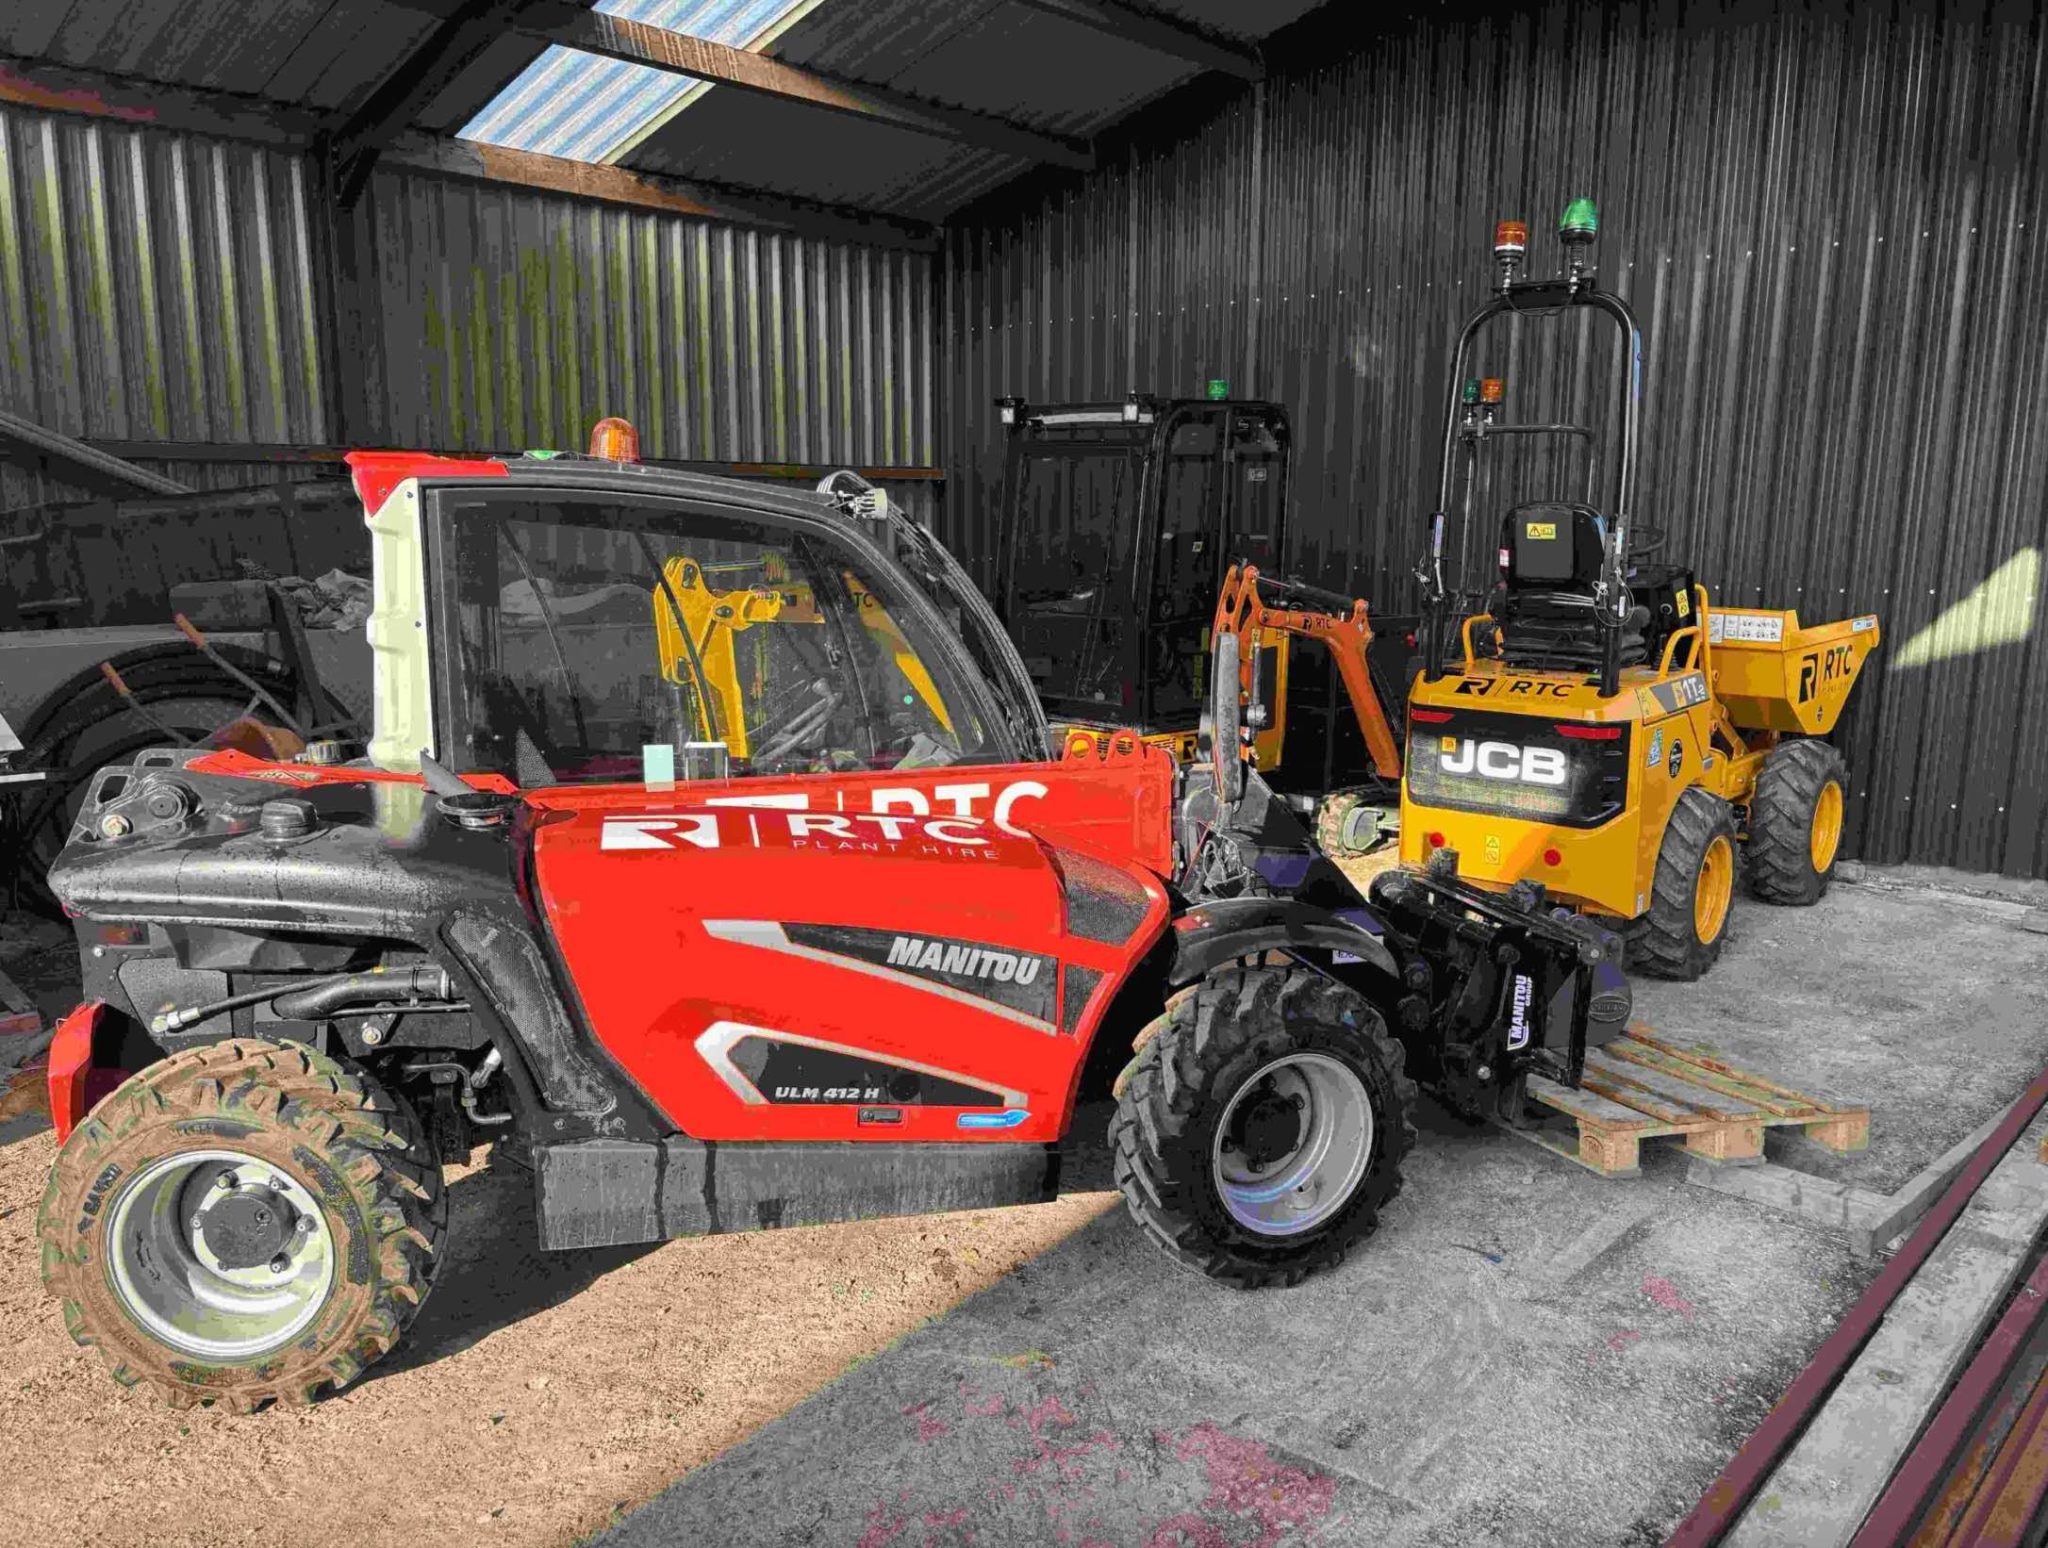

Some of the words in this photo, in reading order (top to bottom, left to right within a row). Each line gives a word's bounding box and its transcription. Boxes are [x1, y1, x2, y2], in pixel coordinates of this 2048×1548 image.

[852, 592, 873, 608] TC
[1824, 644, 1853, 681] RTC
[1509, 681, 1574, 697] RTC
[1441, 739, 1566, 785] JCB
[786, 814, 990, 844] RTC
[793, 840, 898, 853] PLANT
[922, 845, 999, 859] HIRE
[887, 936, 1041, 985] MANITOU
[1511, 974, 1527, 1039] MANITOU
[1525, 976, 1533, 1007] GROUP
[775, 1086, 819, 1099] ULM
[823, 1088, 860, 1098] 412
[863, 1087, 879, 1099] H
